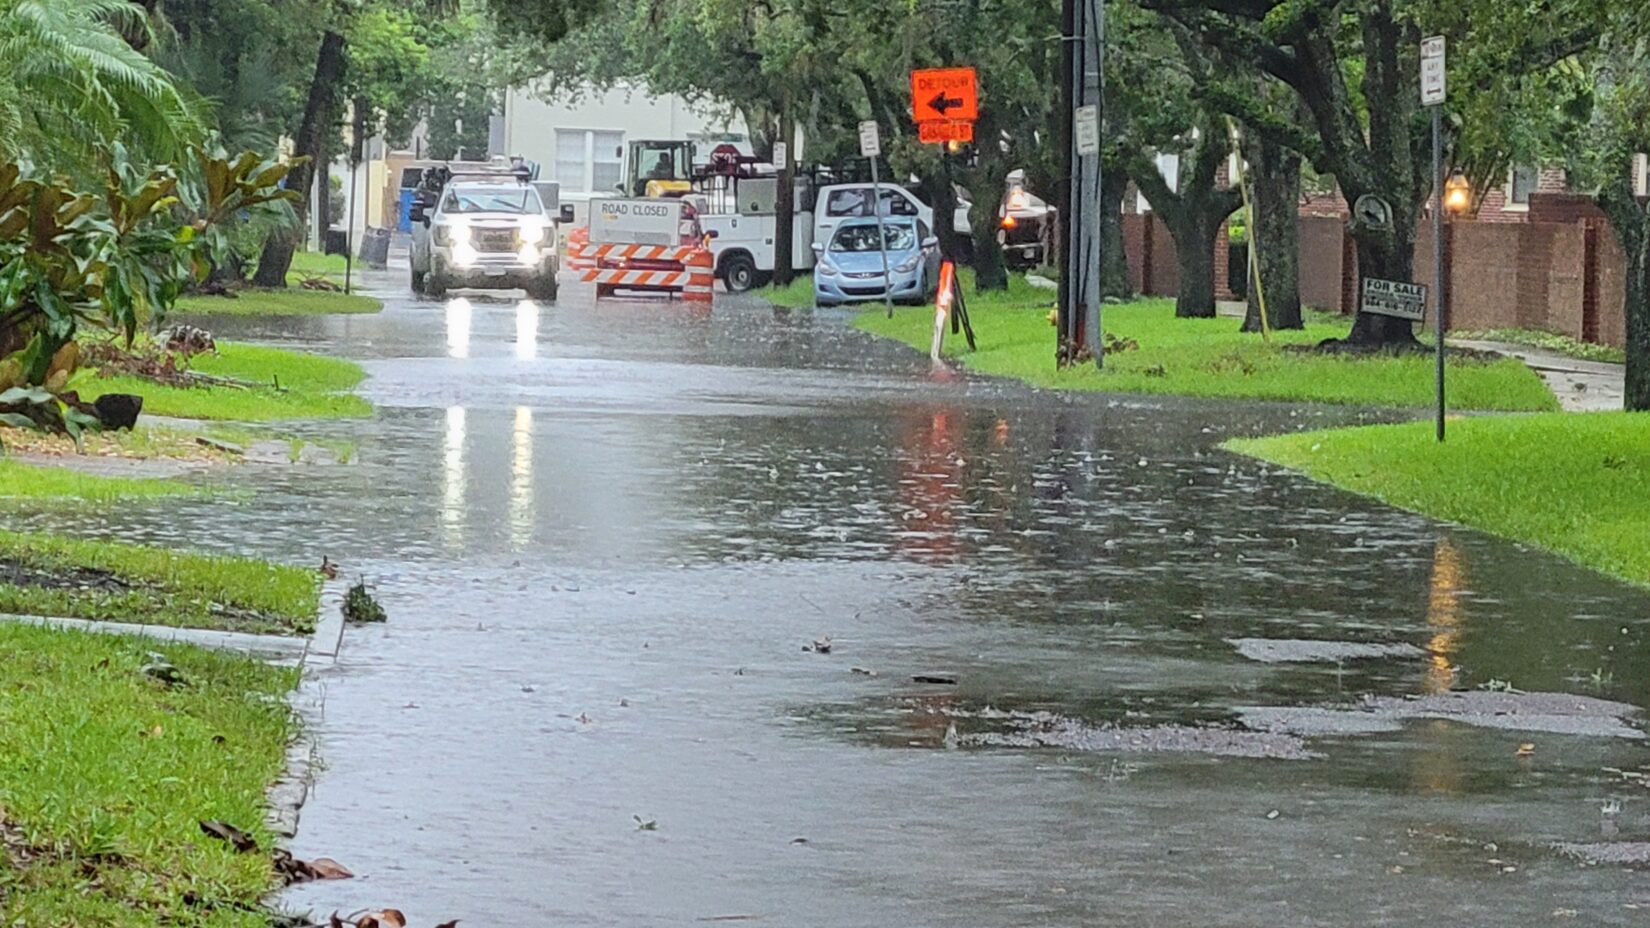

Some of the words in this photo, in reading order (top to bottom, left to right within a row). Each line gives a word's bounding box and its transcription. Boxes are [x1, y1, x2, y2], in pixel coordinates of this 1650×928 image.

[919, 76, 969, 89] DETOUR
[602, 203, 628, 214] ROAD
[633, 204, 668, 217] CLOSED
[1367, 280, 1390, 291] FOR
[1394, 283, 1423, 296] SALE
